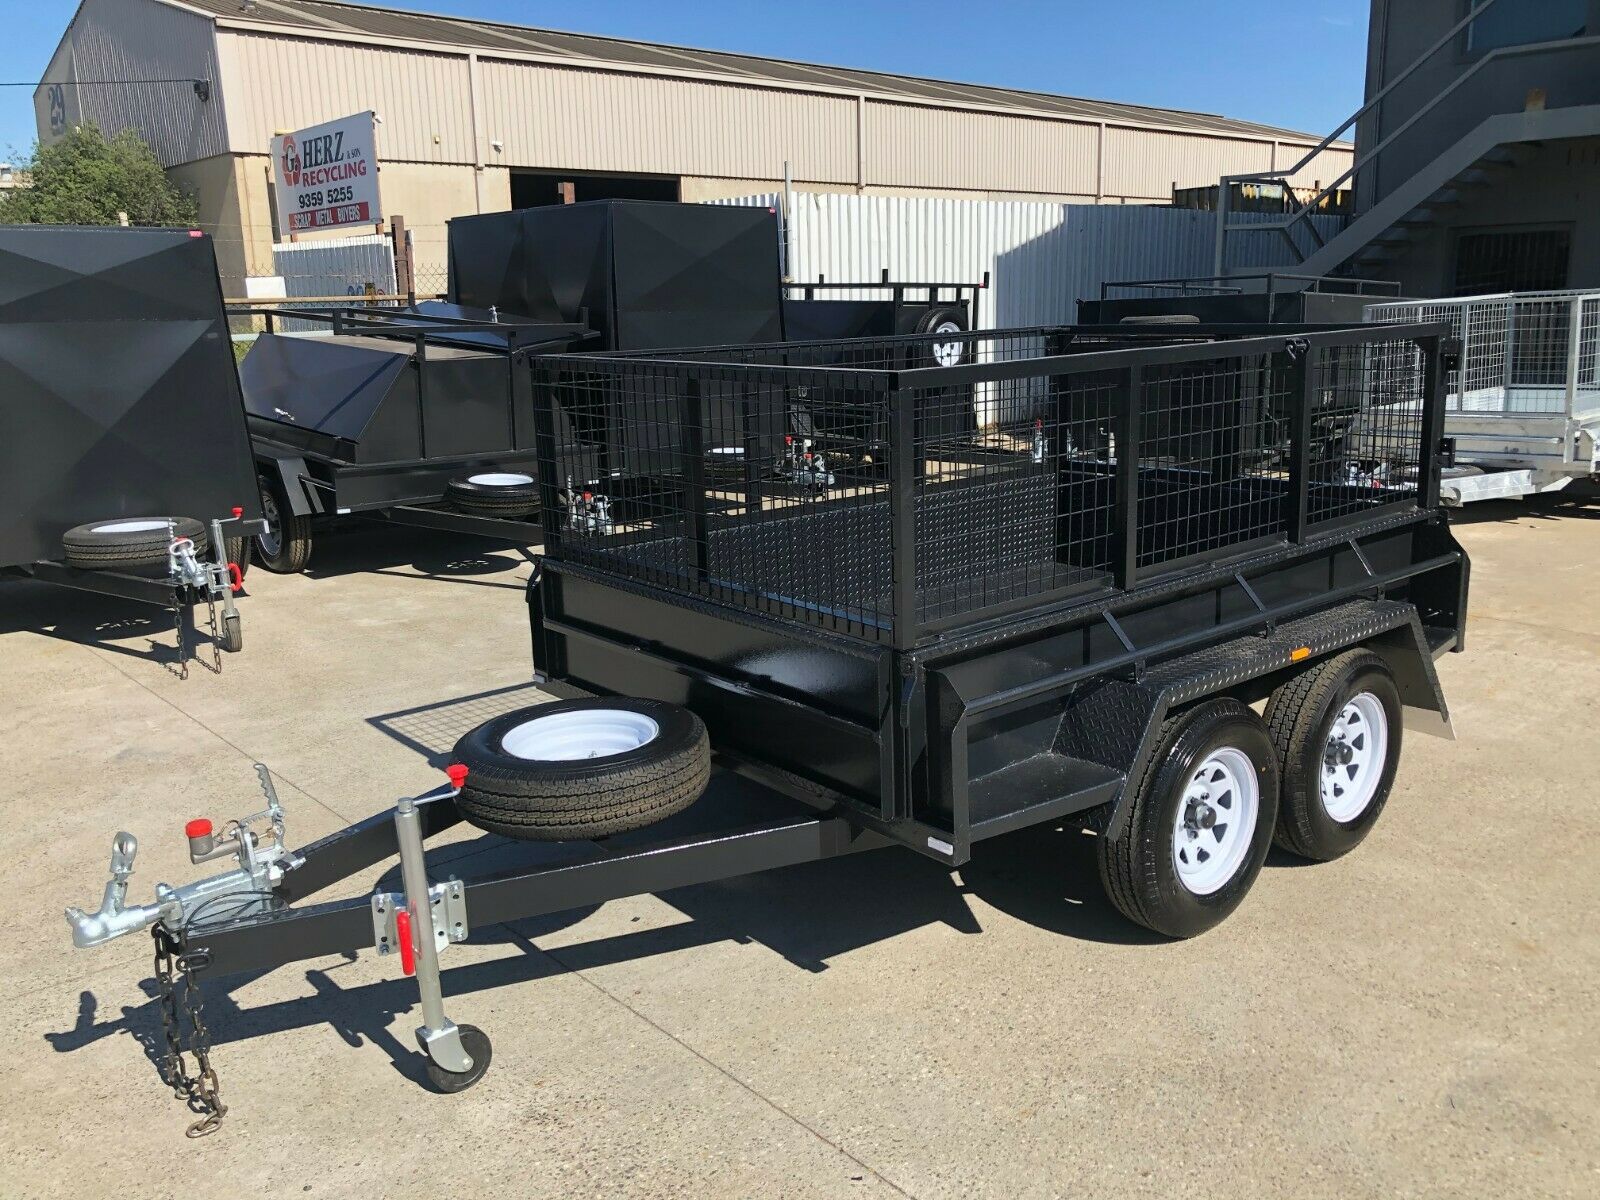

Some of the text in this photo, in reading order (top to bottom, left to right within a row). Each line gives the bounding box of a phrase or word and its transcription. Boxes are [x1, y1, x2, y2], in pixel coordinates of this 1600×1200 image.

[48, 84, 66, 126] 29
[302, 131, 345, 169] HERZ
[302, 159, 367, 187] RECYCLING
[298, 185, 353, 209] 9359 5255
[294, 204, 361, 227] SCRAP METAL BUYERS
